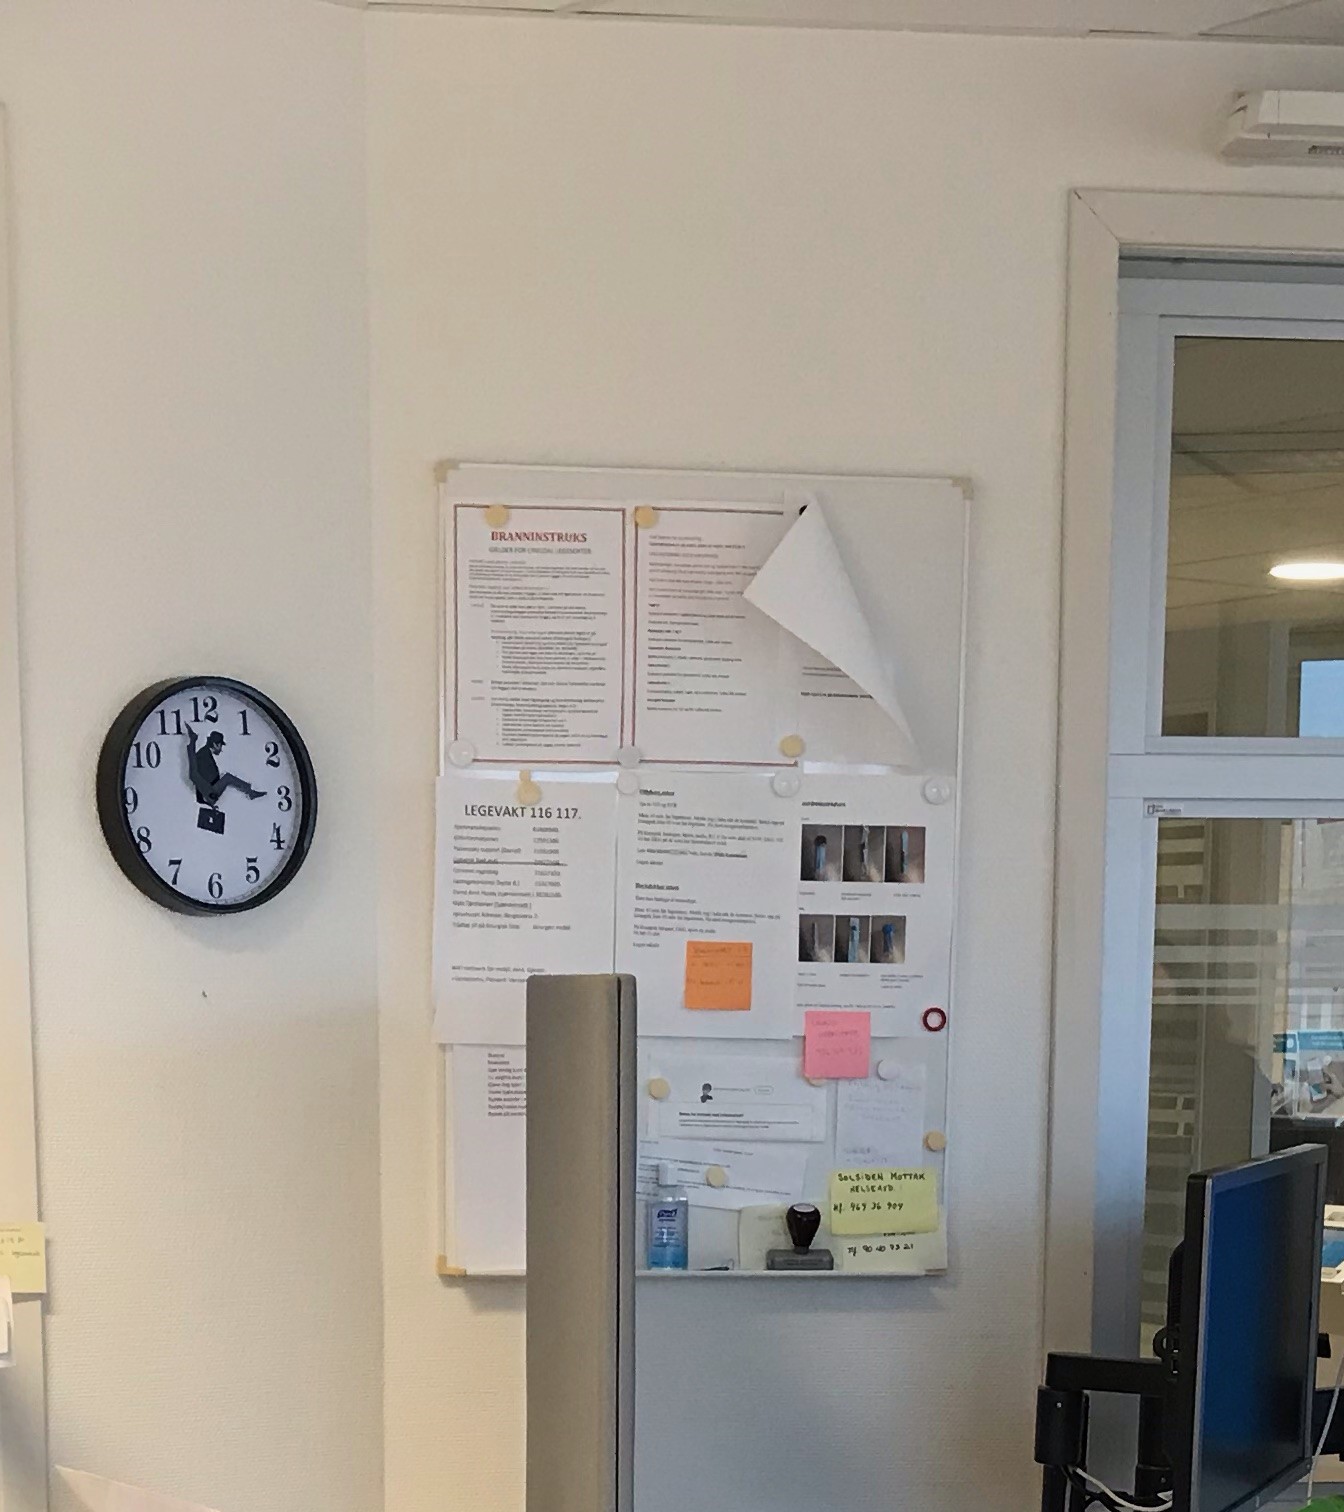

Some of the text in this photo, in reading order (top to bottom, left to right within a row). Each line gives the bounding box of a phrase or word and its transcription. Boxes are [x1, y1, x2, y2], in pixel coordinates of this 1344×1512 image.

[490, 531, 588, 543] BRANNINSTRUKS
[156, 709, 183, 735] 11
[189, 695, 219, 724] 12
[238, 709, 251, 736] 1
[132, 742, 161, 769] 10
[264, 741, 281, 768] 2
[124, 787, 138, 814] 9
[276, 785, 293, 812] 3
[464, 804, 582, 820] LEGEVAKT 116 117.
[136, 826, 152, 854] 8
[269, 822, 285, 850] 4
[168, 858, 183, 886] 7
[245, 857, 260, 884] 5
[208, 872, 223, 899] 6
[837, 1172, 926, 1182] SOLSIDEN MOTTAK
